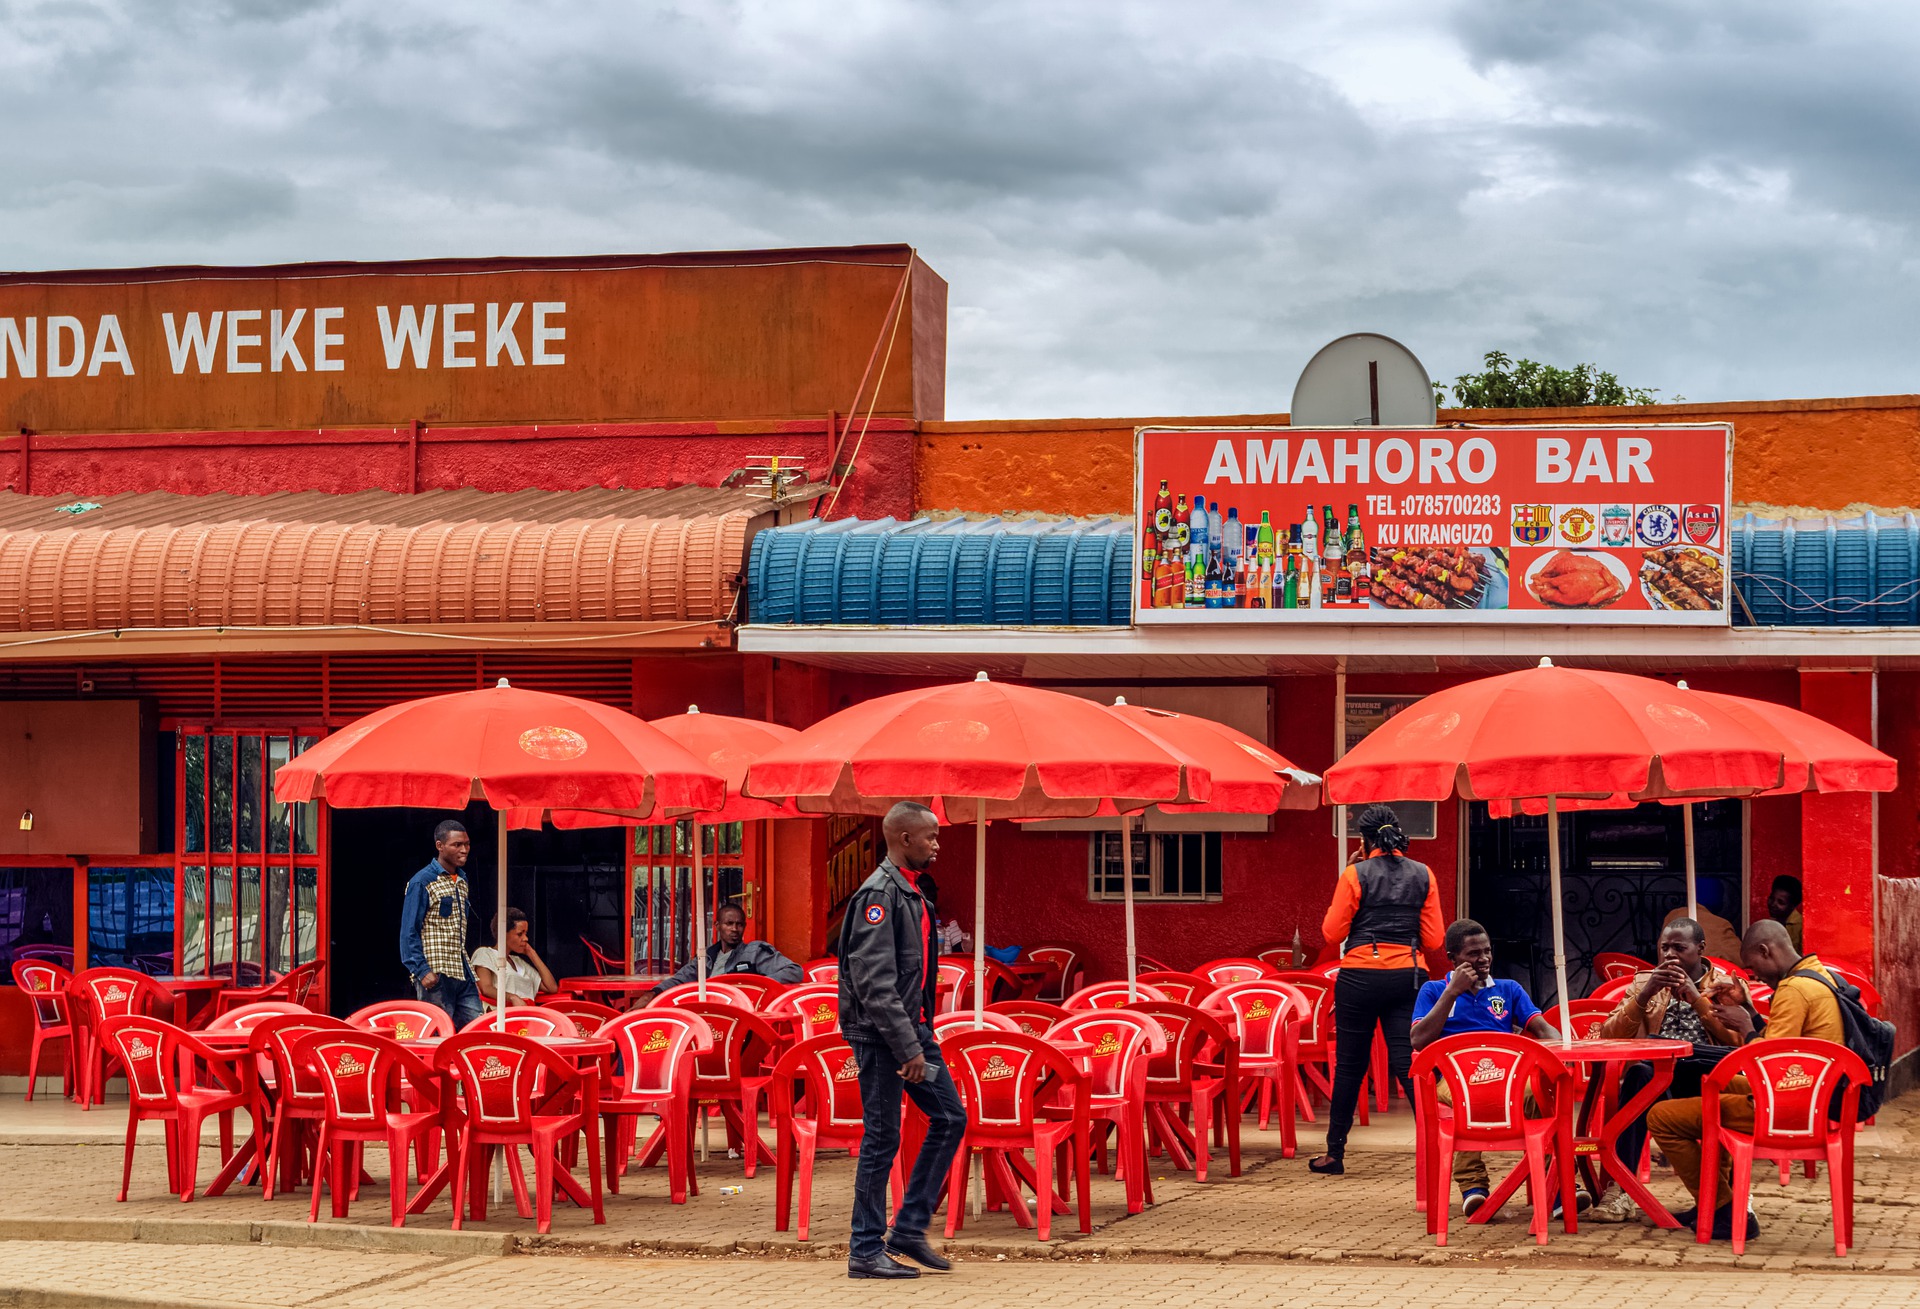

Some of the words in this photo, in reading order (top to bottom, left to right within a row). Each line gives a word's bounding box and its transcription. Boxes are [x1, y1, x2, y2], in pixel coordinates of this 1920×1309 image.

[0, 314, 136, 378] NDA
[162, 307, 345, 374] WEKE
[377, 302, 566, 370] WEKE
[1203, 438, 1497, 485] AMAHORO
[1536, 438, 1655, 484] BAR
[1366, 495, 1396, 515] TEL
[1643, 504, 1672, 517] CHELSEA
[1561, 509, 1592, 522] MANCHESTER
[1378, 524, 1399, 545] KU
[1404, 524, 1493, 545] KIRANGUZO
[1642, 537, 1660, 546] FOOTBALL
[335, 1066, 362, 1076] KING
[480, 1068, 508, 1079] KING
[837, 1070, 858, 1080] KIN
[981, 1069, 1012, 1079] KING
[1471, 1072, 1502, 1083] KING
